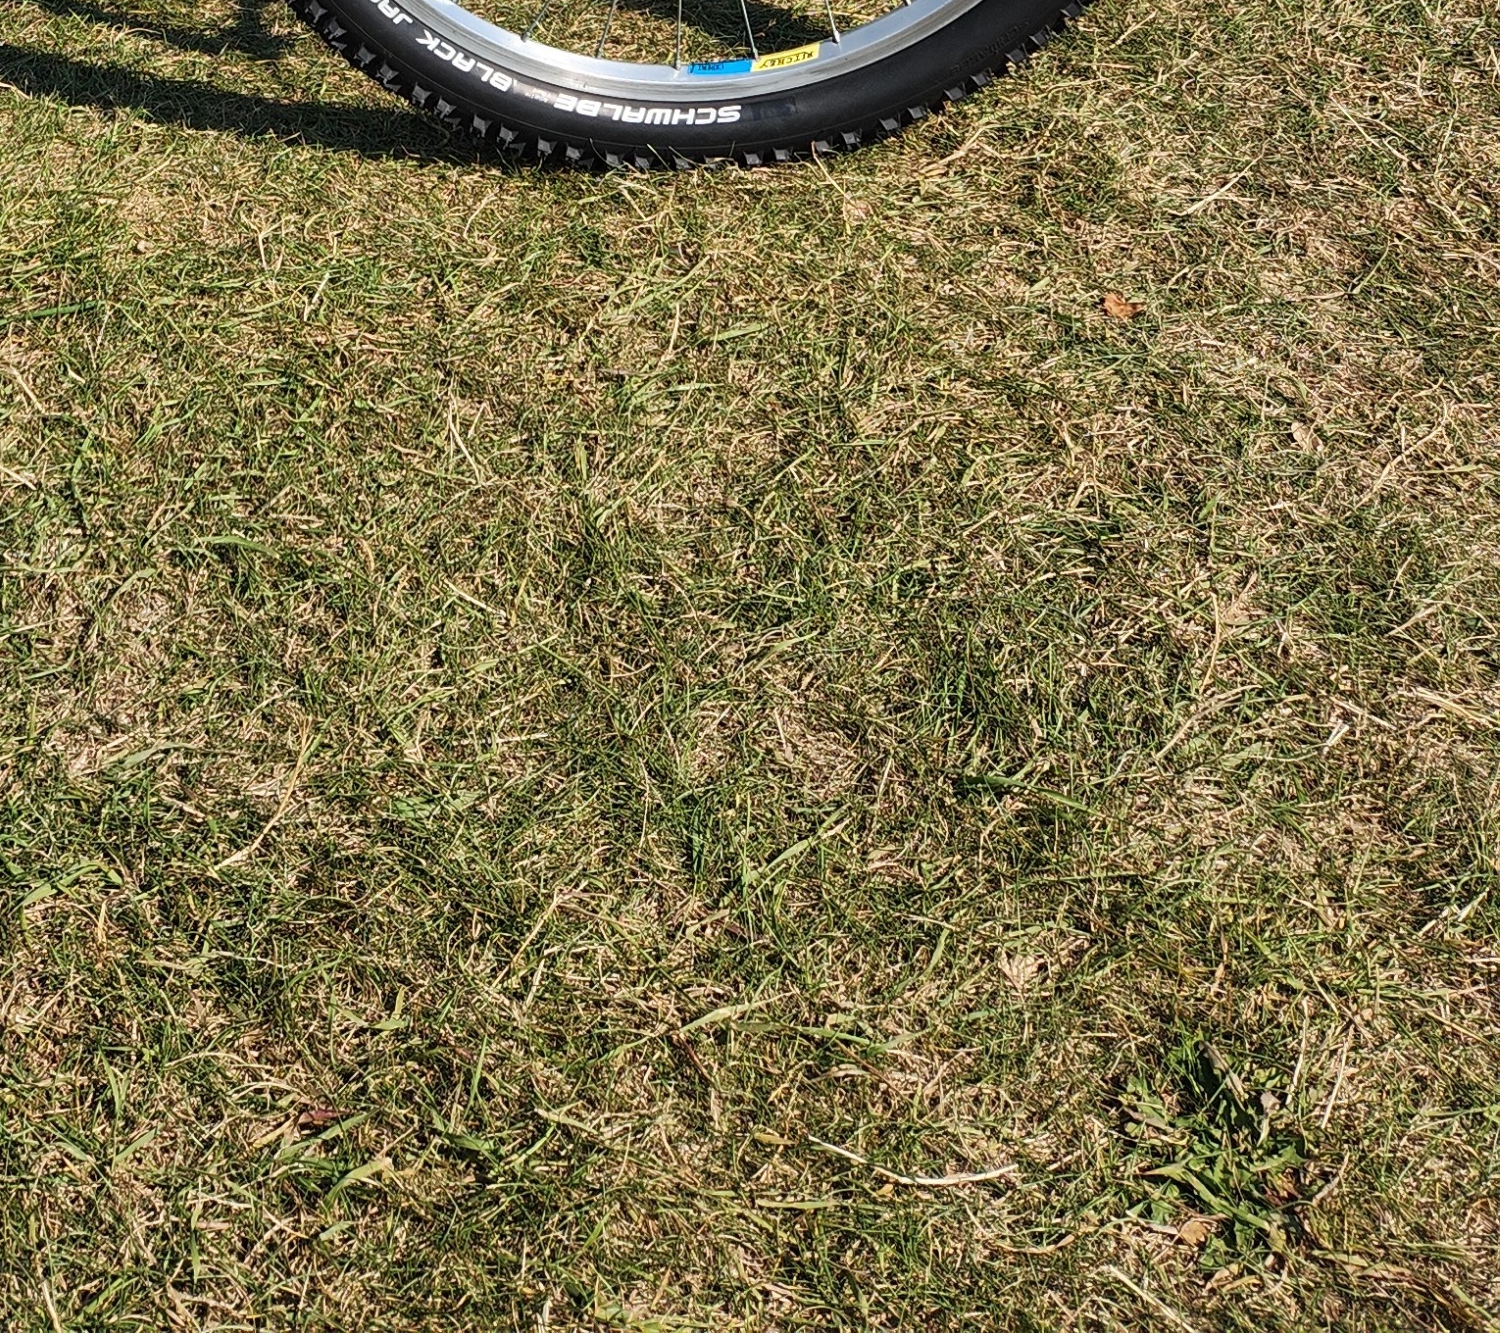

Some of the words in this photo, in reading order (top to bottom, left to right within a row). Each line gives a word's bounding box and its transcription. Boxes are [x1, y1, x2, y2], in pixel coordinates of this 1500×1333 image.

[415, 29, 514, 93] BLACK
[758, 50, 814, 69] RITCHEY
[554, 93, 742, 125] SCHWALBE
